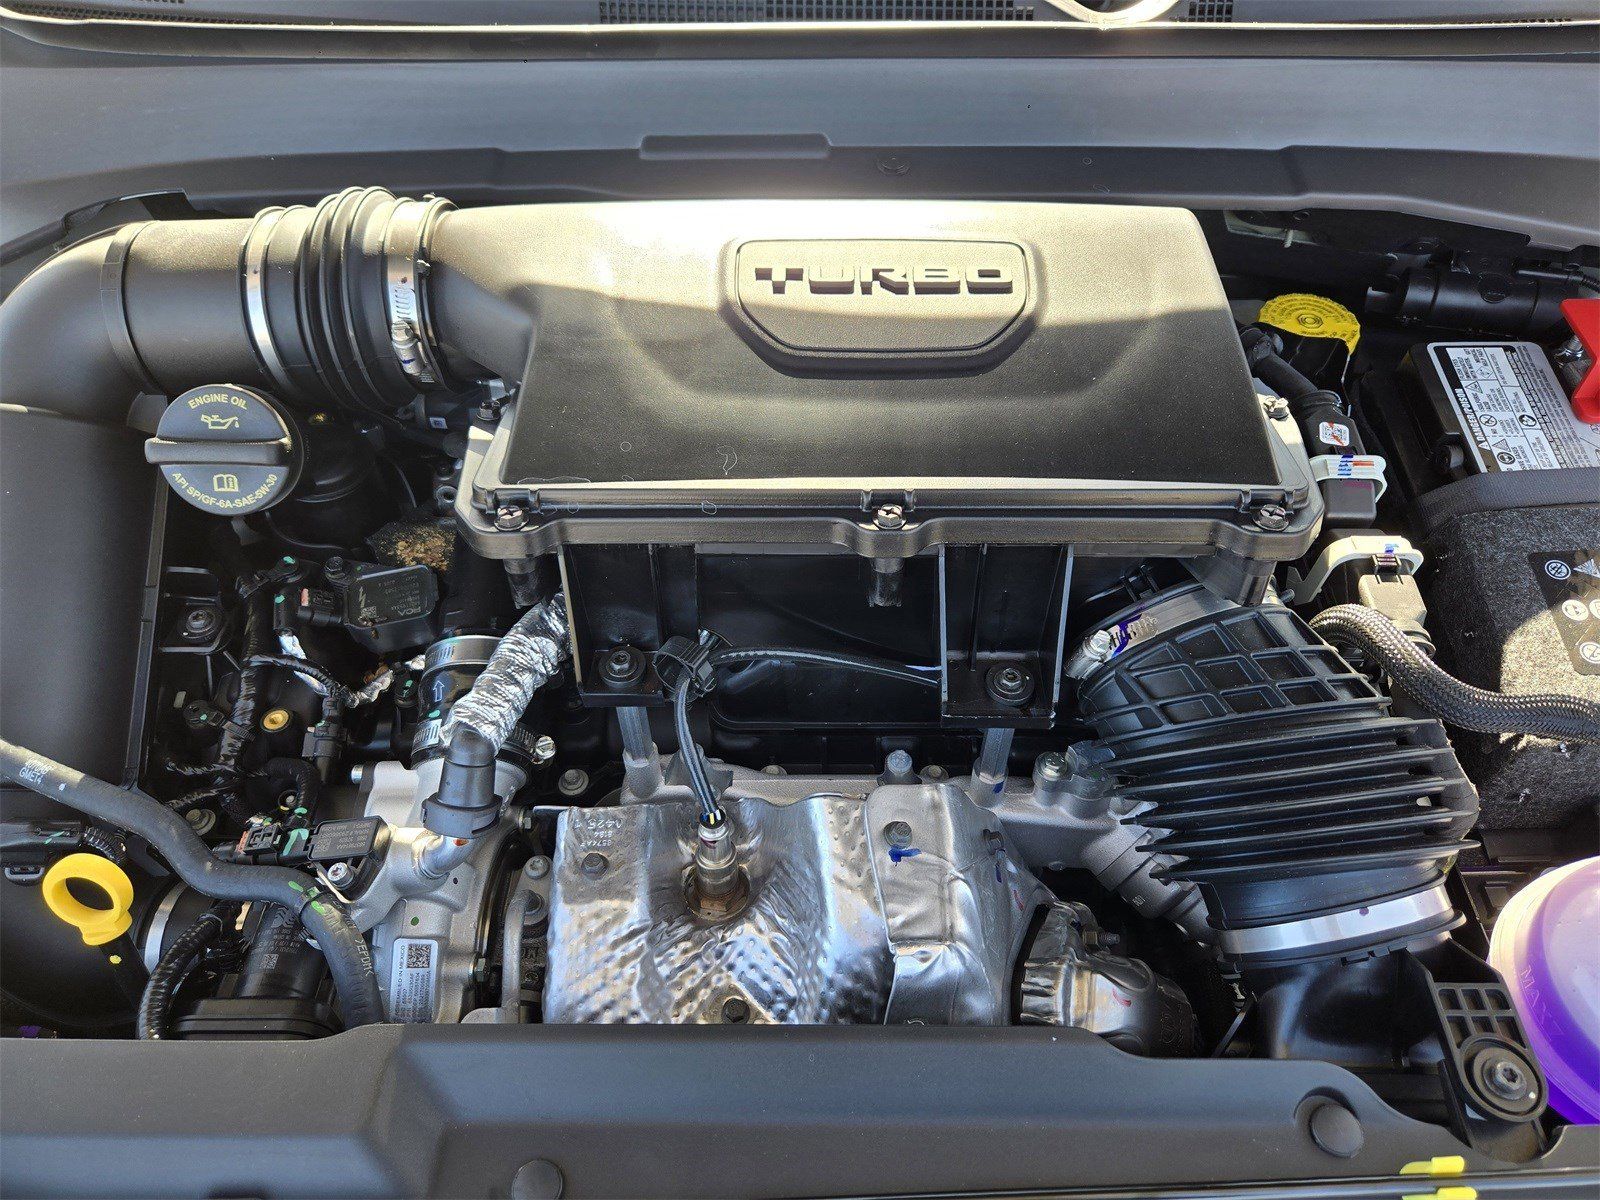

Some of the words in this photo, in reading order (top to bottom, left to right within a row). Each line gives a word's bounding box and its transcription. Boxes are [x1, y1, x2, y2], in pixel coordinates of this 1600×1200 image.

[754, 264, 1013, 295] TURBO
[187, 393, 229, 410] ENGINE
[231, 396, 248, 410] OIL
[172, 472, 188, 488] API
